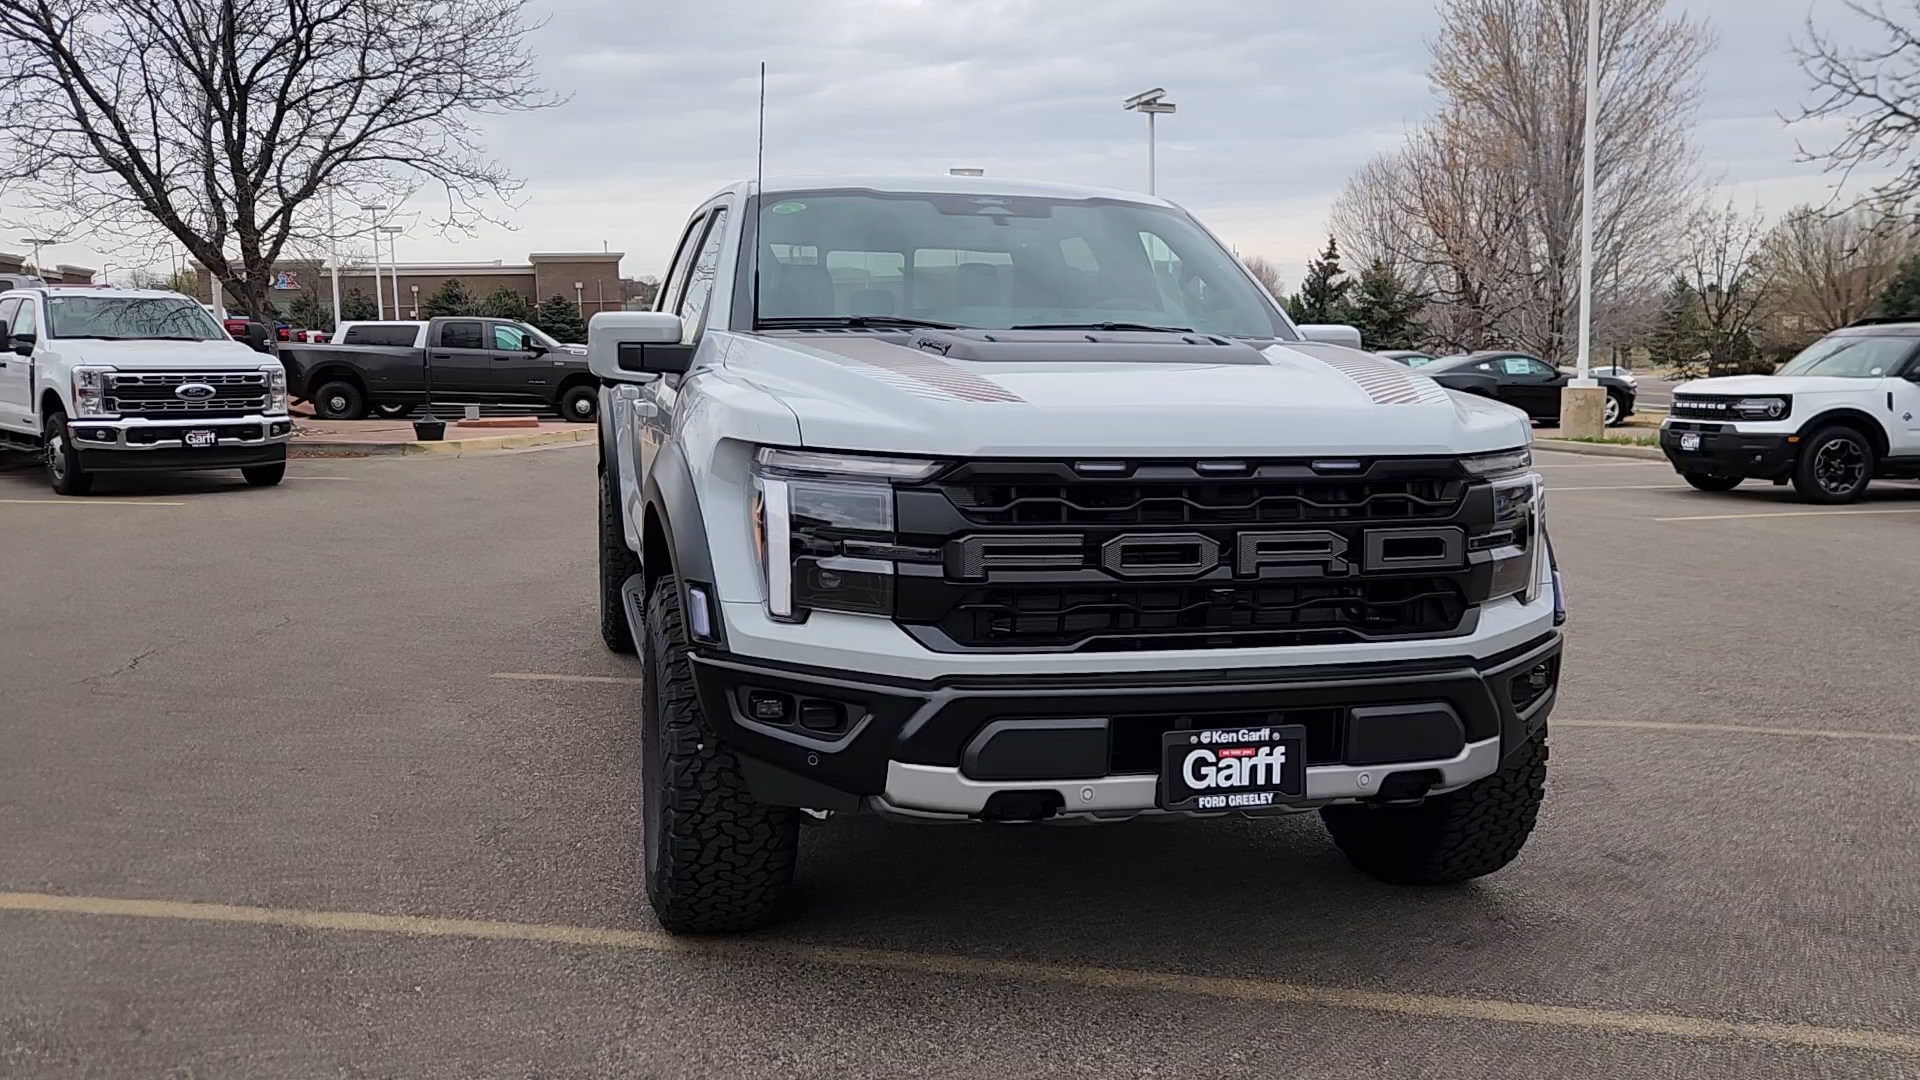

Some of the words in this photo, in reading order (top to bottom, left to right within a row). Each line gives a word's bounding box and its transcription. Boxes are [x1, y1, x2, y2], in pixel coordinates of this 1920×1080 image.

[187, 388, 206, 396] Ford
[185, 432, 216, 444] Garff
[948, 526, 1466, 580] FORD
[1212, 730, 1237, 743] Ken
[1238, 728, 1270, 742] Garff
[1183, 746, 1286, 789] Garff
[1199, 795, 1226, 808] FORD
[1228, 793, 1274, 806] GREELEY
